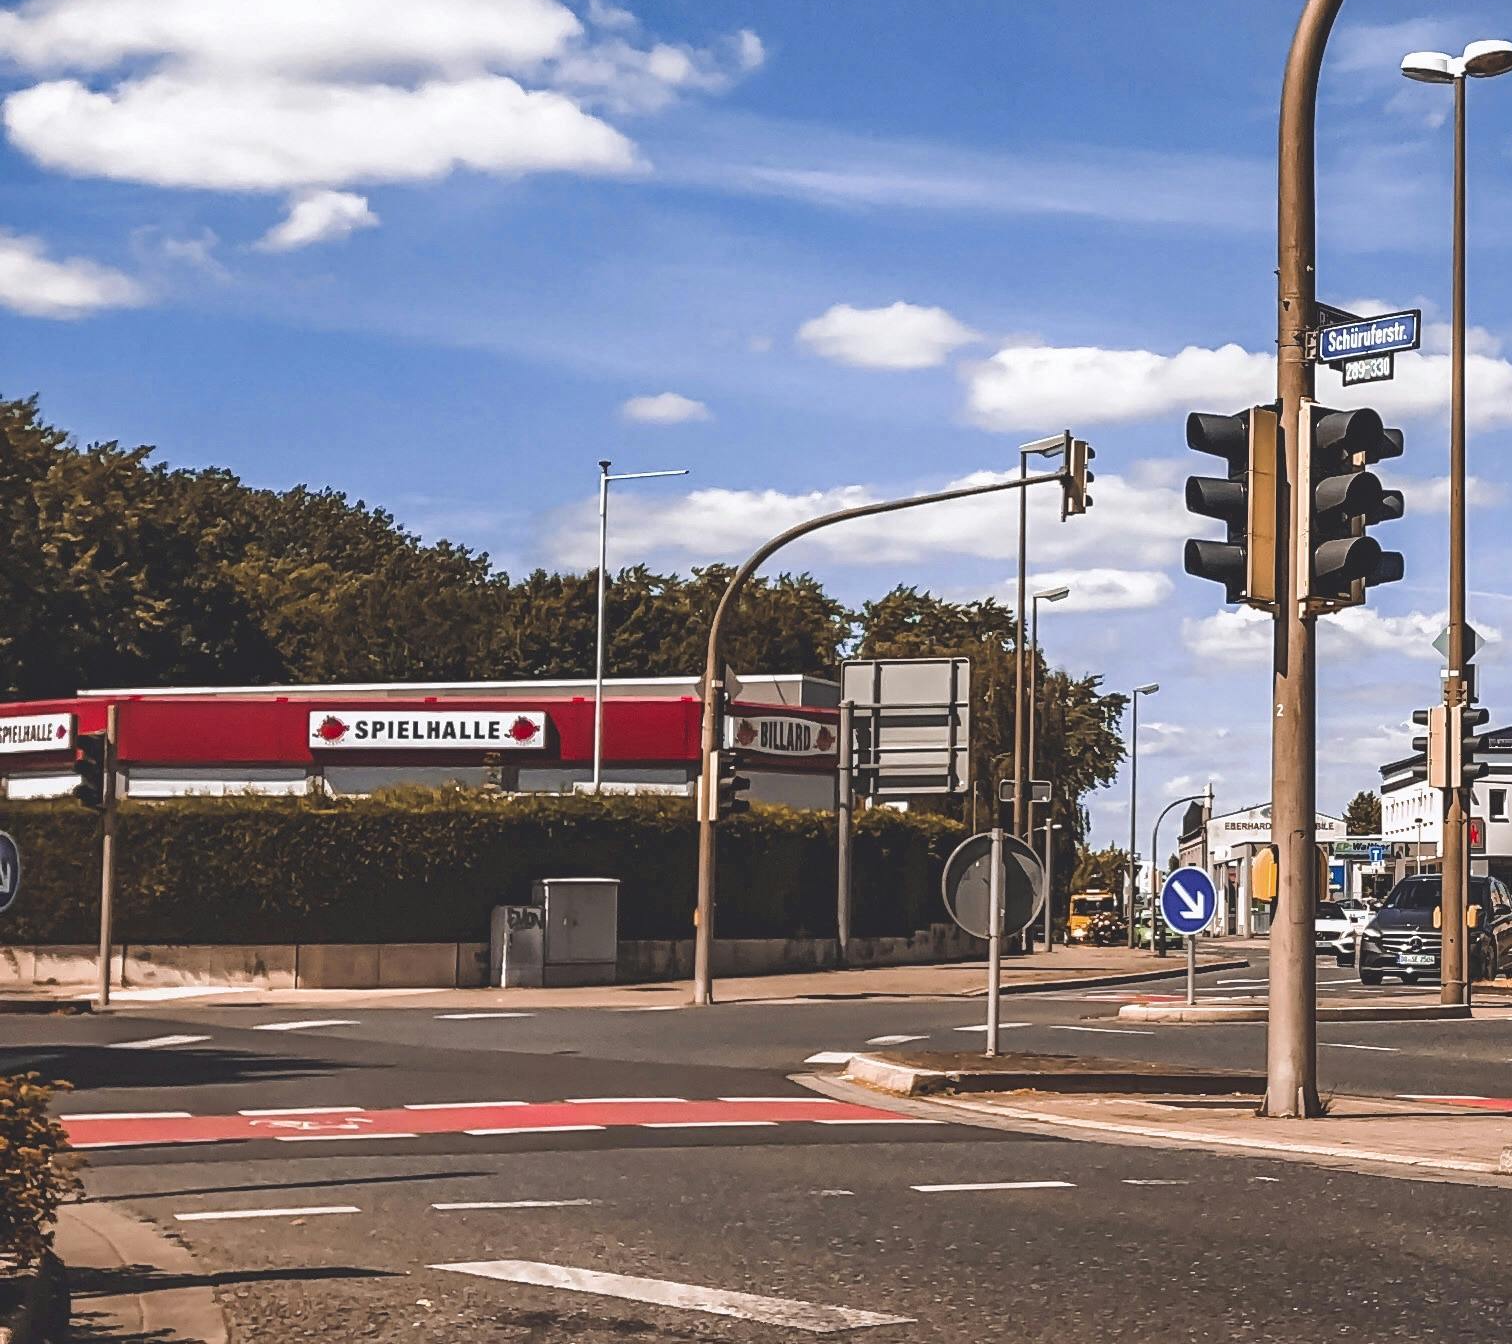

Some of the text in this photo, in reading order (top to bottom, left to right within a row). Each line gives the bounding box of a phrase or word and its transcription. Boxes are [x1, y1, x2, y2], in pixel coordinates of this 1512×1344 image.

[1328, 322, 1407, 351] Schüruferstr.
[354, 720, 501, 740] SPIELHALLE
[760, 721, 811, 752] BILLARD
[1224, 822, 1272, 831] EBERHARD
